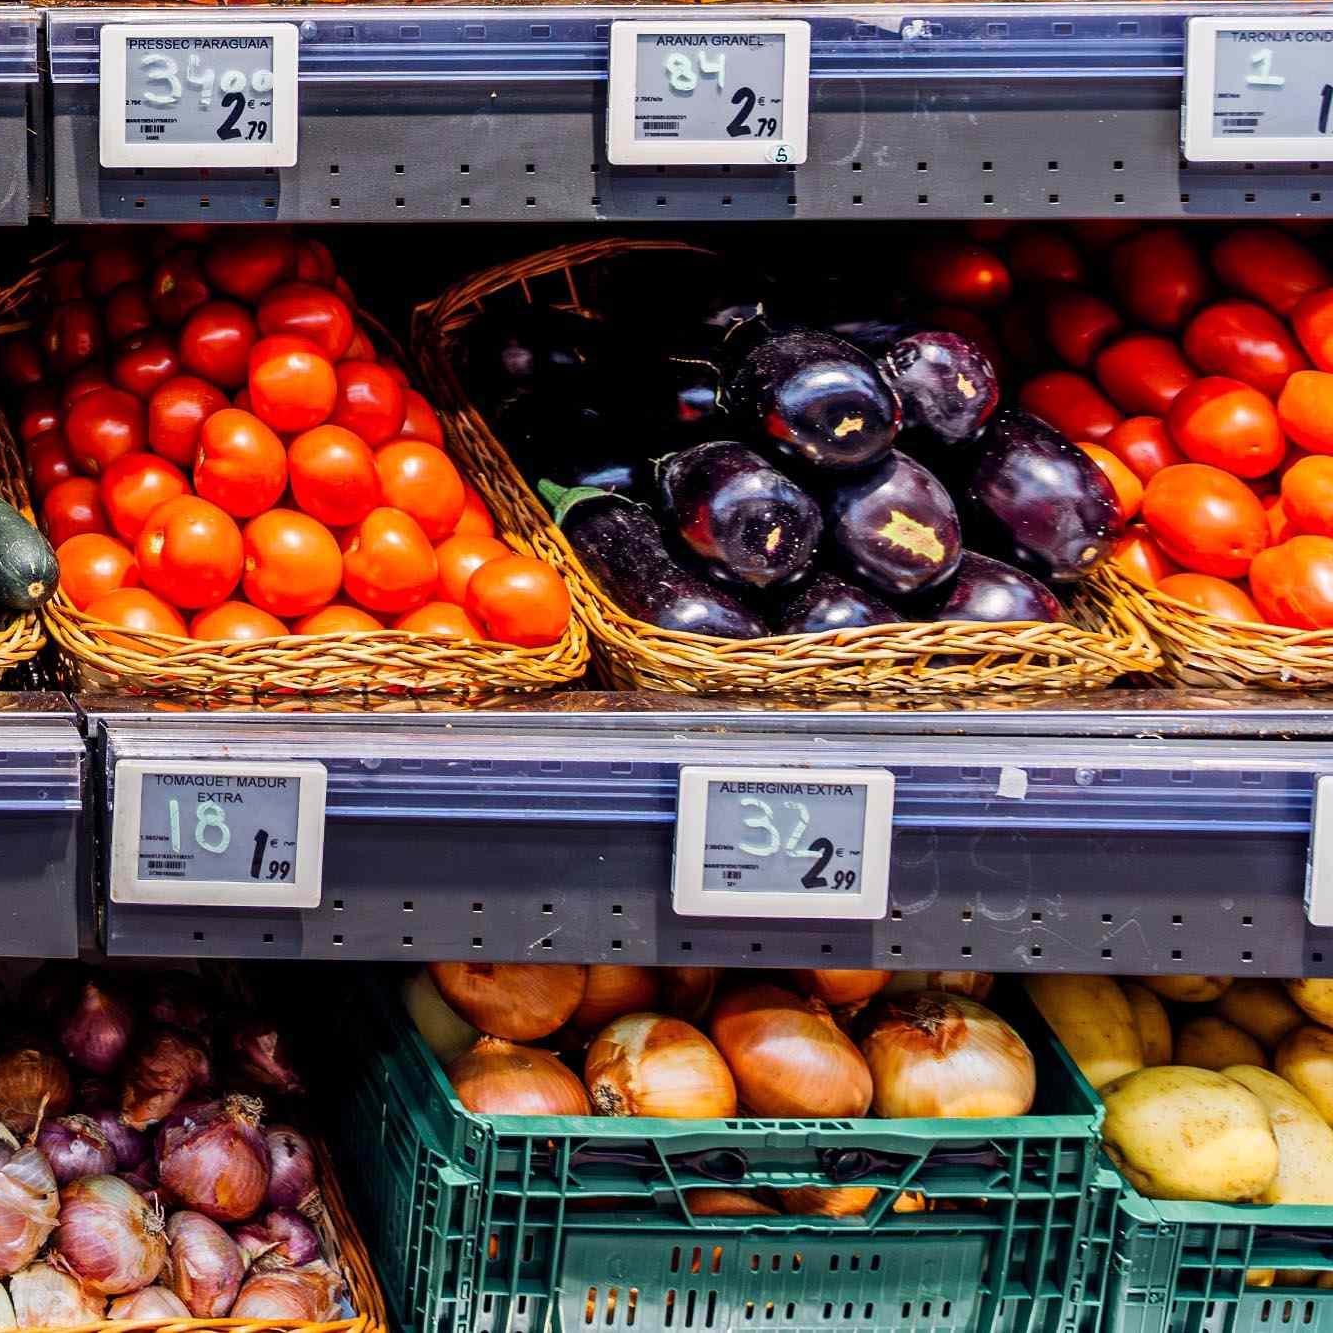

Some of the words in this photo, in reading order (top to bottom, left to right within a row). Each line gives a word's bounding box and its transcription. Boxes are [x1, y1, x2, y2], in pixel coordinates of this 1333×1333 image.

[656, 35, 708, 47] ARANJA
[711, 35, 764, 47] GRANEL
[1231, 31, 1292, 43] TARONJA
[129, 39, 191, 50] PRESSEC
[194, 39, 269, 50] PARAGUAIA
[666, 50, 726, 91] 84
[1244, 48, 1286, 86] 1
[155, 775, 231, 787] TOMAQUET
[236, 777, 287, 789] MADUR
[720, 782, 804, 795] ALBERGINIA
[807, 784, 854, 796] EXTRA
[197, 792, 244, 804] EXTRA
[169, 799, 231, 854] 18
[739, 797, 824, 857] 32
